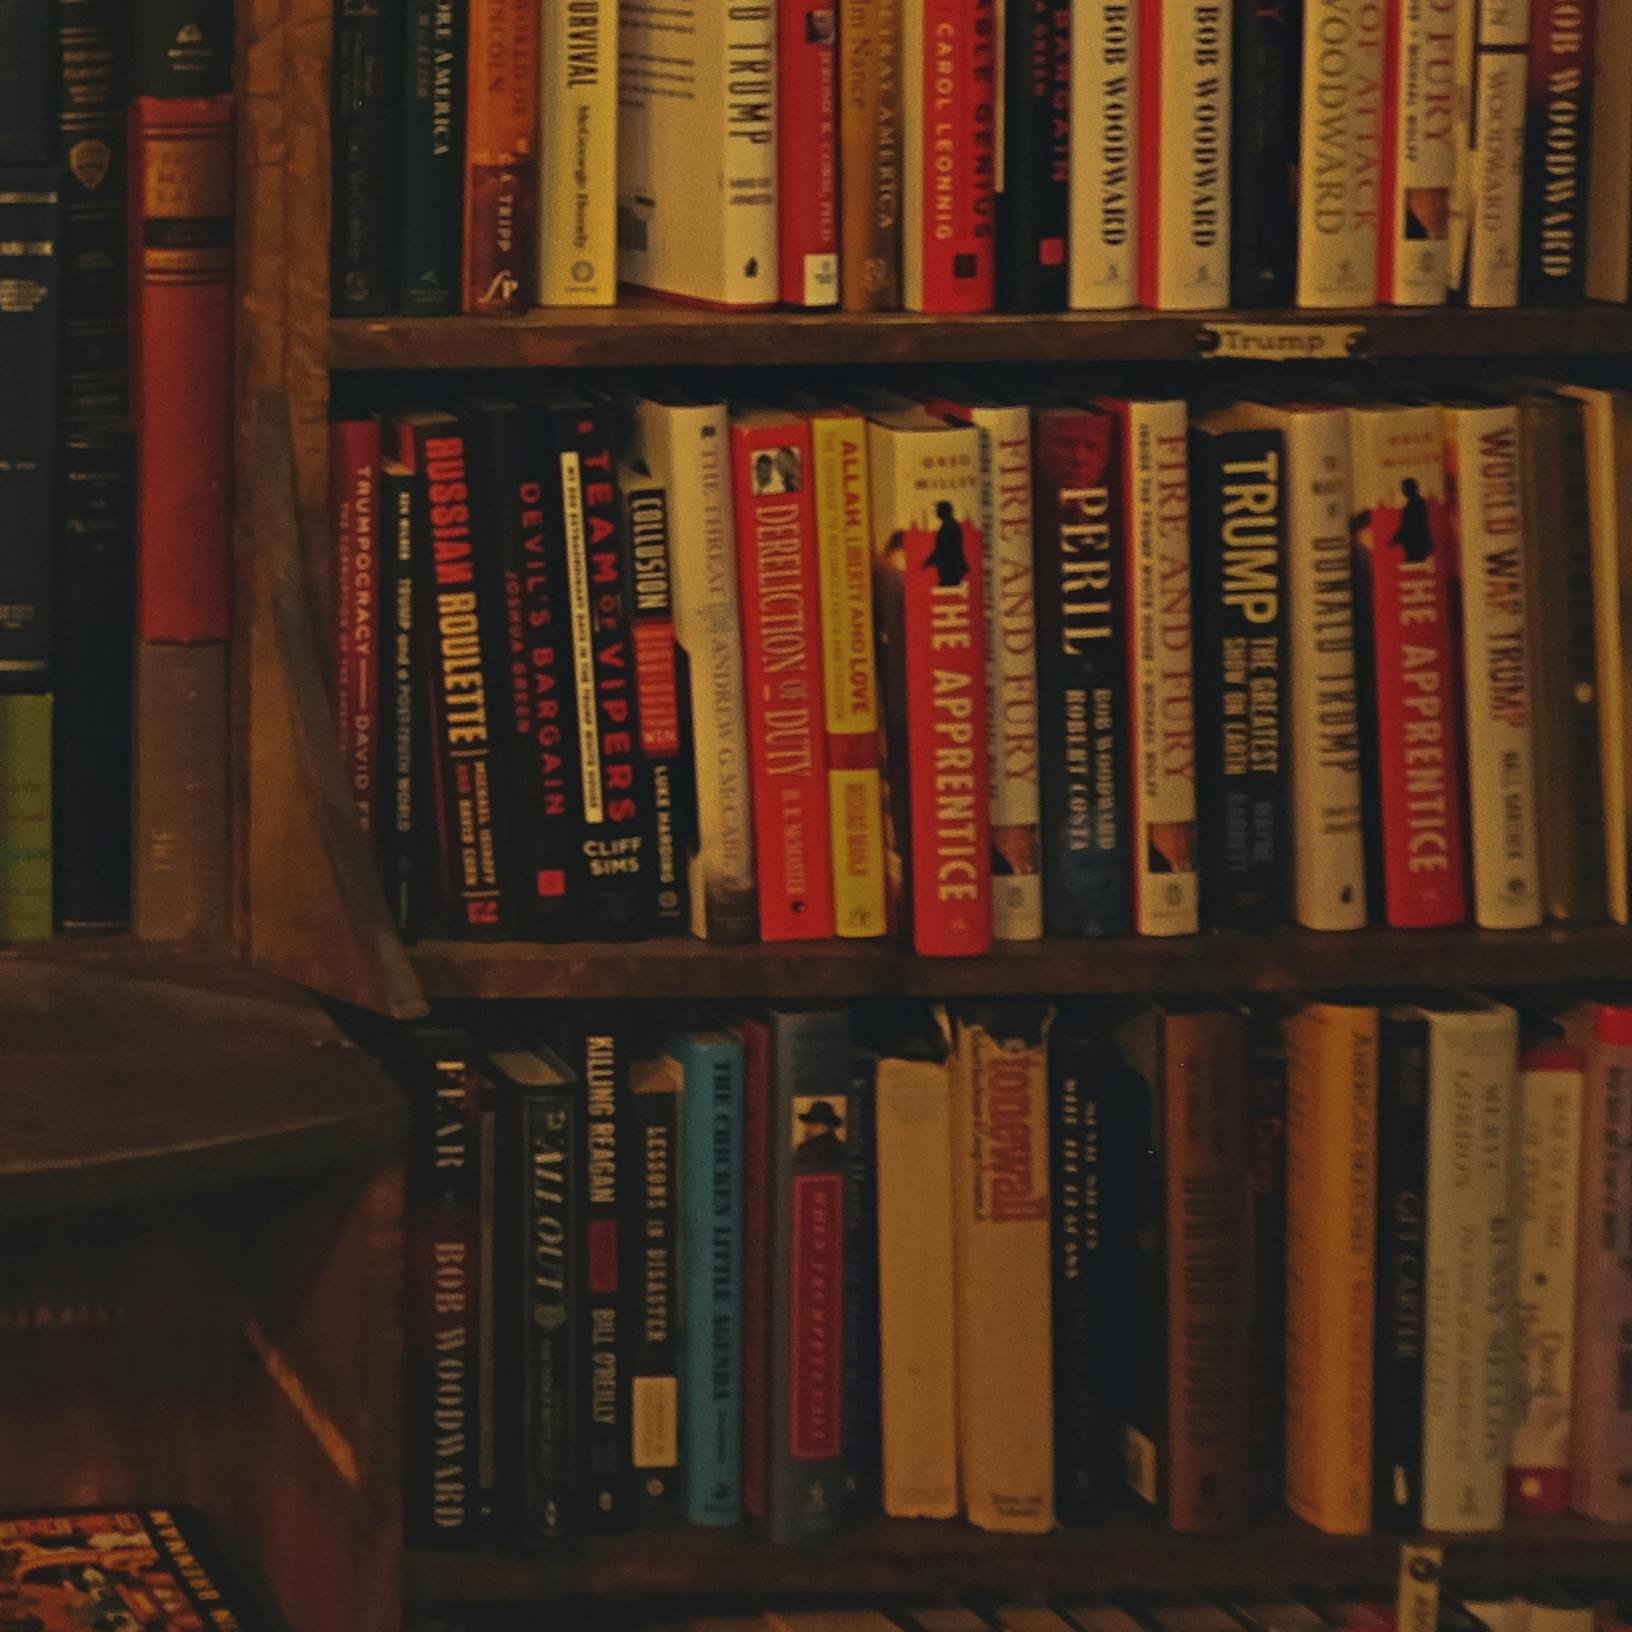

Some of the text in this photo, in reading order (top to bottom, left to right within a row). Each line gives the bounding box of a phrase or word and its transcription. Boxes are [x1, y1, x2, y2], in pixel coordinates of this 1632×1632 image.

[727, 39, 772, 146] TRUMP
[935, 22, 955, 108] CAROL
[1101, 5, 1127, 67] BOB
[1193, 5, 1220, 67] BOB
[933, 123, 954, 239] LEONNIG
[1101, 74, 1128, 247] WOODWARD
[1193, 76, 1221, 248] WOODWARD
[1541, 70, 1580, 277] WOODWARD
[1222, 331, 1325, 354] Trump
[353, 464, 372, 657] TRUMPOCRACY
[426, 437, 487, 742] RUSSIAN ROULETTE
[632, 497, 666, 609] COLLUSION
[1059, 487, 1113, 656] PERIL
[1157, 434, 1193, 784] FIRE AND FURY
[1220, 451, 1279, 623] TRUMP
[1478, 429, 1529, 727] WORLD WAR TRUMP
[519, 482, 566, 815] DEVIL'S BARGAIN
[586, 451, 636, 822] TEAM VIPERS
[757, 503, 811, 778] DERELICTION DUTY
[1397, 563, 1448, 874] THE APPRENTICE
[653, 767, 673, 884] LUKE HARDING
[930, 583, 978, 901] THE APPRENTICE
[583, 838, 641, 858] CLIFF
[589, 859, 640, 876] SIMS
[588, 1035, 616, 1204] KILLING REAGAN
[988, 1038, 1046, 1223] tonewall
[434, 1061, 467, 1529] FEAR BOB WOODWARD
[645, 1126, 668, 1343] LESSONS DISASTER
[711, 1116, 735, 1400] CHICKEN LITTLE AGENDA
[592, 1310, 616, 1426] BILL O'REILLY
